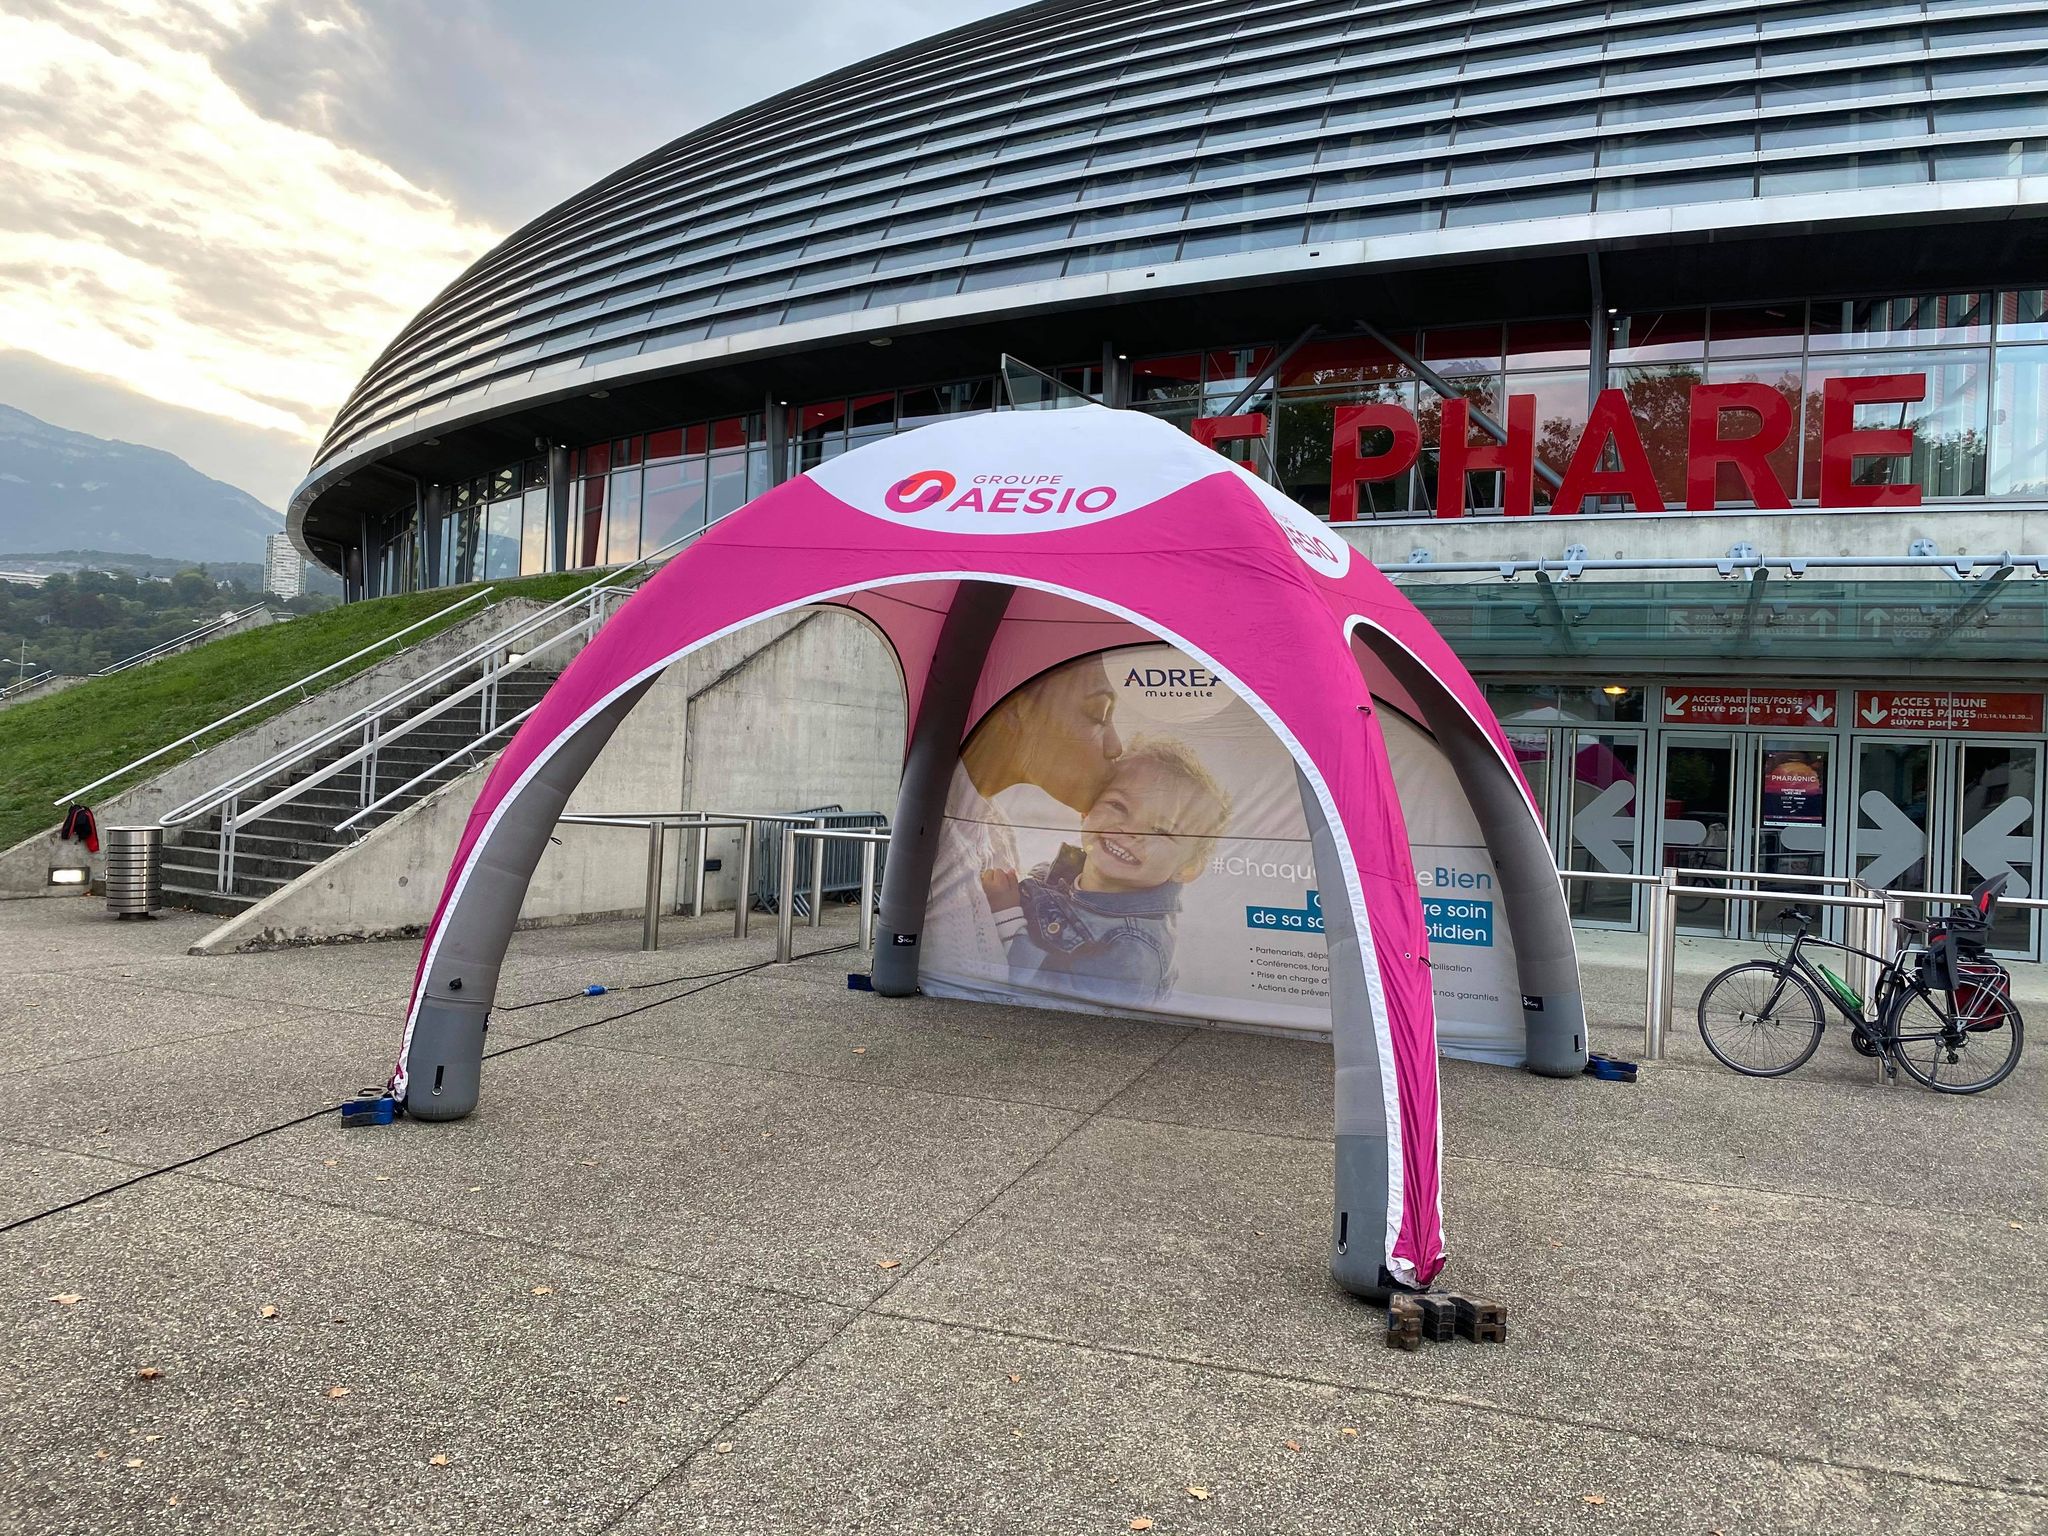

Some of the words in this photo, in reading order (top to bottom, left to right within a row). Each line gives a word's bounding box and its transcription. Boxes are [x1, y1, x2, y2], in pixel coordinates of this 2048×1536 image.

[1329, 373, 1926, 522] PHARE
[972, 475, 1063, 485] GROUPE
[945, 486, 1117, 514] AESIO
[1691, 695, 1721, 703] ACCES
[1891, 697, 1931, 707] ACCES
[1934, 698, 1987, 708] TRBUNE
[1691, 703, 1726, 713] suivre
[1765, 705, 1771, 714] 1
[1794, 705, 1803, 714] 2
[1891, 708, 1934, 717] PORTES
[1890, 717, 1925, 726] suivre
[1961, 719, 1970, 727] 2
[1211, 856, 1317, 883] #Chaqu
[1415, 867, 1492, 890] eBien
[1447, 903, 1487, 919] soin
[1252, 910, 1277, 925] de
[1281, 914, 1302, 927] sa
[1424, 923, 1487, 941] otidien
[1255, 946, 1306, 958] Partenariats,
[1256, 958, 1310, 971] Conférences,
[1311, 964, 1330, 973] foru
[1257, 971, 1275, 980] Prise
[1276, 973, 1288, 981] en
[1289, 974, 1320, 985] charge
[1257, 983, 1287, 993] Actions
[1288, 986, 1300, 994] de
[1301, 989, 1330, 998] préven
[1438, 990, 1455, 998] nos
[1456, 991, 1499, 1002] garanties
